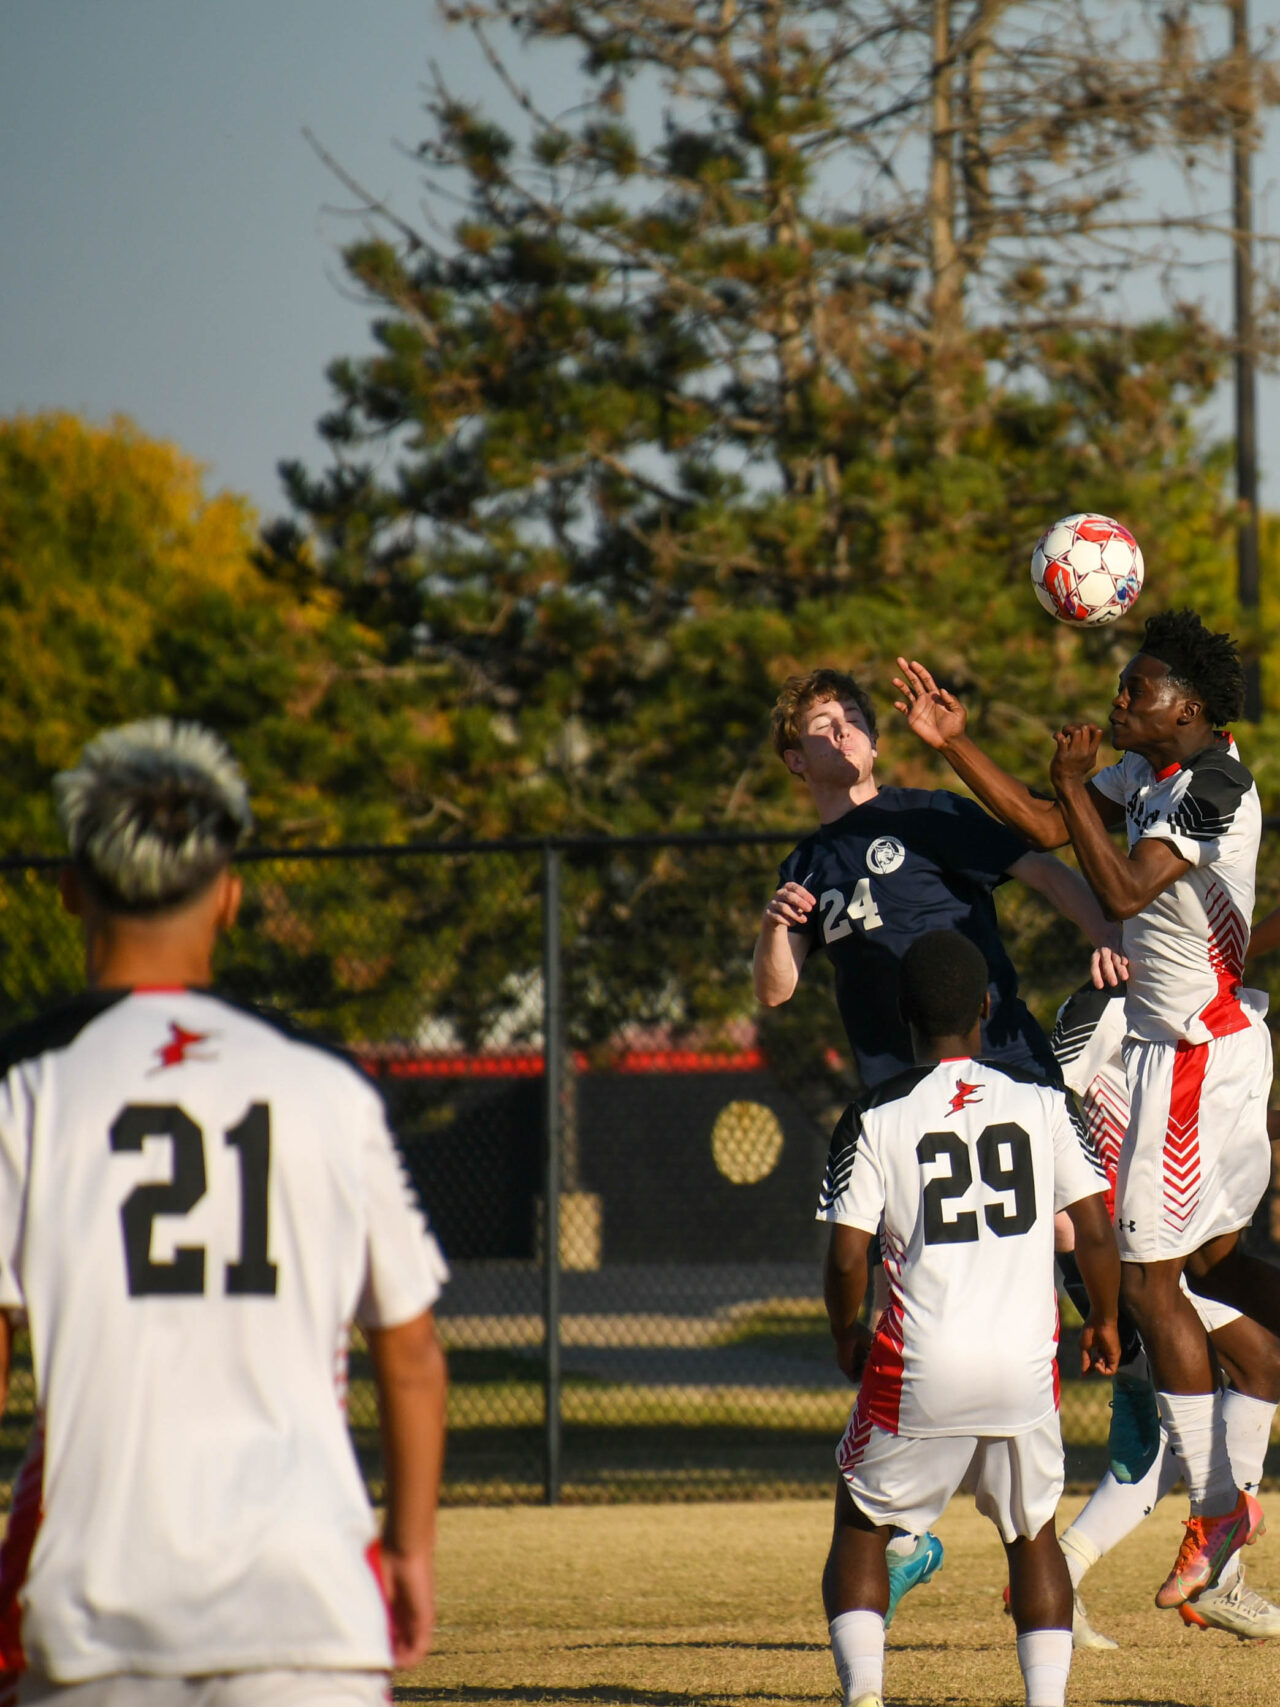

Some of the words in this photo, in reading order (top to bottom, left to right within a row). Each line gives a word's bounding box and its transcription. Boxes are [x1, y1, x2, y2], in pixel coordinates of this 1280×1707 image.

[819, 877, 884, 944] 24
[109, 1101, 278, 1297] 21
[916, 1122, 1037, 1246] 29
